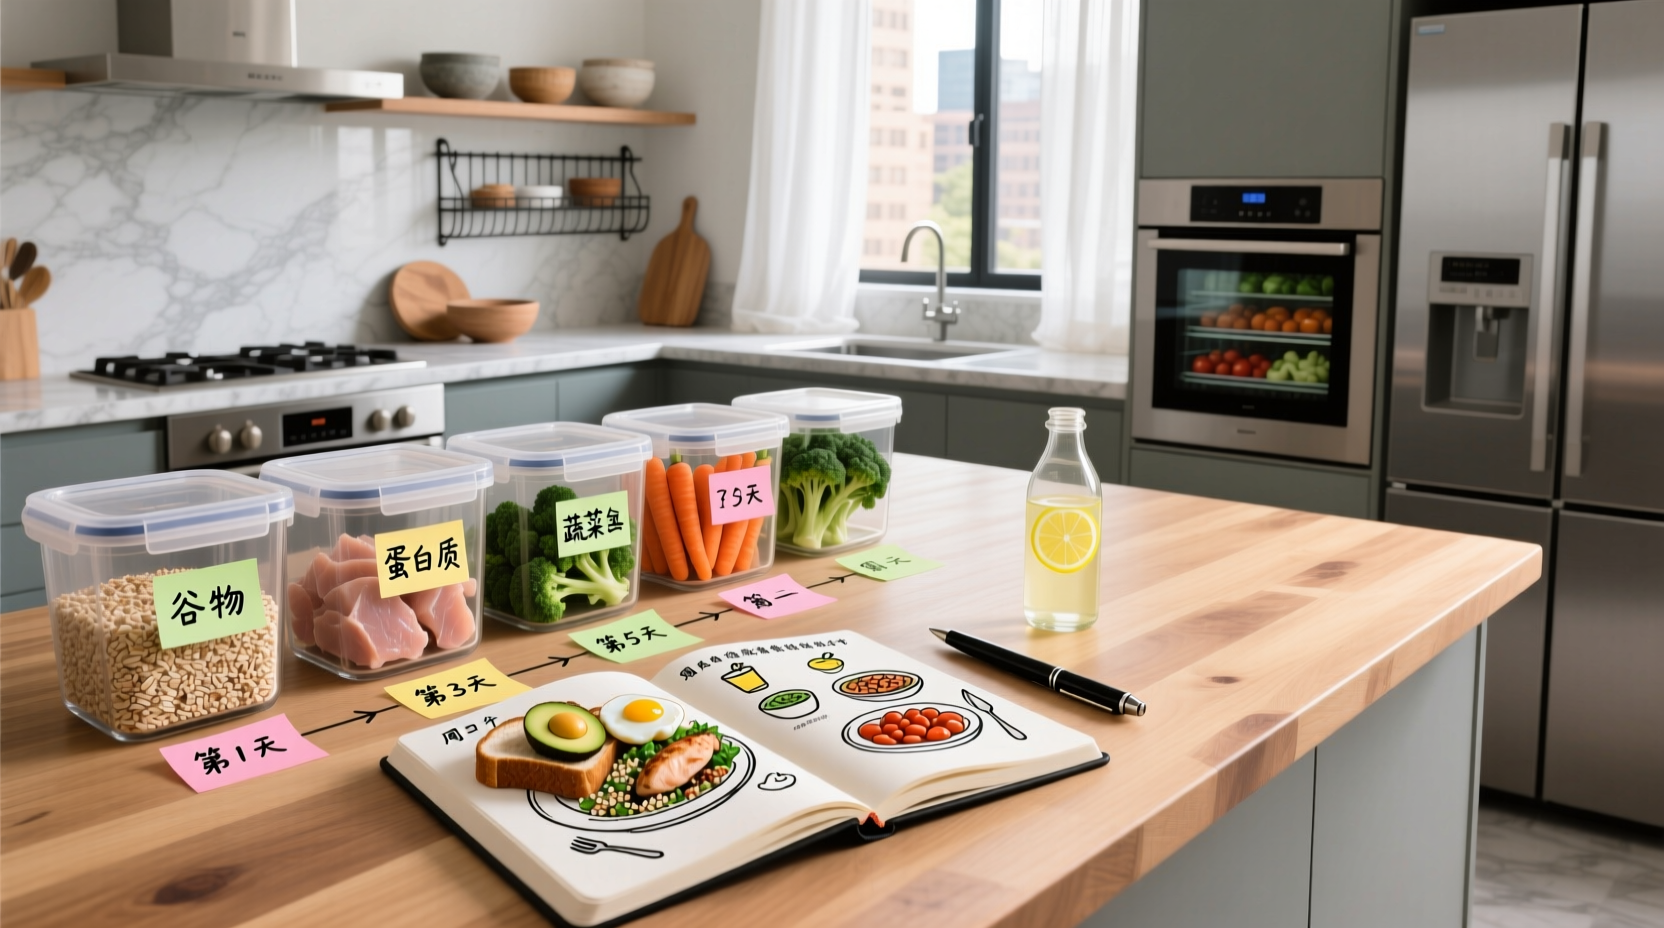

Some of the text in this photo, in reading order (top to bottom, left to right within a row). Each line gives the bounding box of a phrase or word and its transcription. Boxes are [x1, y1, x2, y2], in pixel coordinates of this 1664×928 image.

[384, 537, 461, 580] 蛋白质
[171, 584, 244, 626] 谷物
[596, 626, 667, 653] 第5天
[415, 675, 497, 707] 第3天
[194, 735, 287, 775] 第1天
